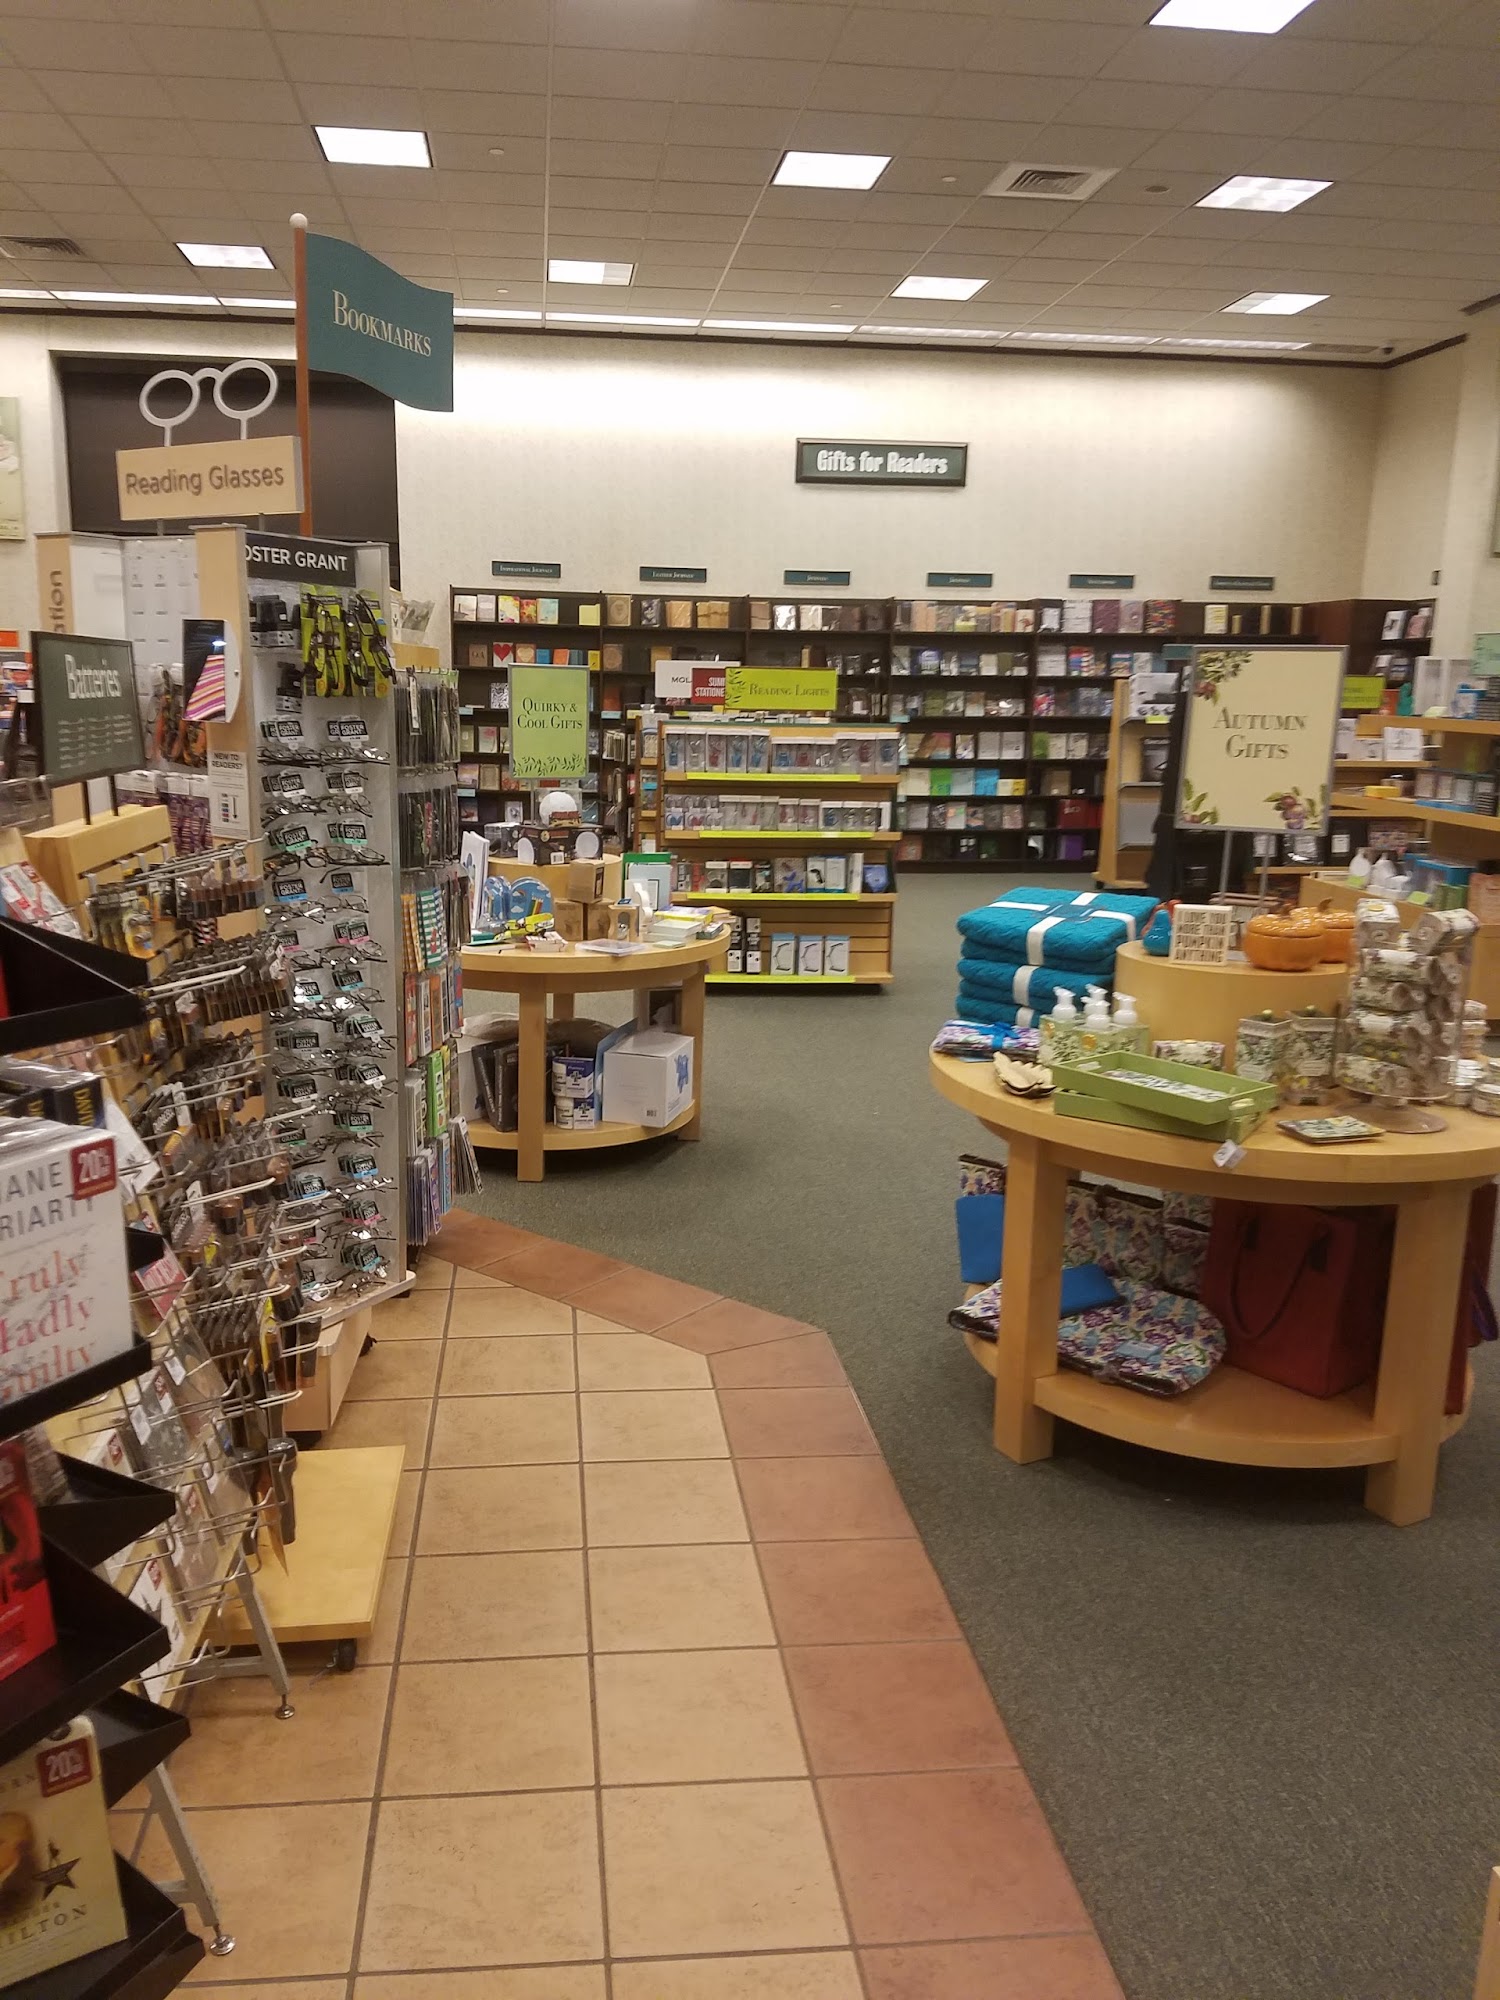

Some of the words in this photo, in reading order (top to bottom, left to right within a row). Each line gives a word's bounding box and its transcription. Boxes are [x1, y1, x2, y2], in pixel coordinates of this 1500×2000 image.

[332, 289, 432, 357] BOOKMARKS
[817, 449, 856, 472] Gifts
[859, 451, 884, 472] for
[886, 451, 948, 474] Readers
[125, 468, 202, 497] Reading
[208, 464, 284, 491] Glasses
[244, 544, 292, 566] OSTER
[294, 551, 348, 571] GRANT
[64, 653, 122, 699] Batteries
[749, 684, 792, 696] READING
[795, 684, 830, 697] LIGHTS
[522, 697, 567, 715] QUIRKY
[569, 703, 578, 713] &
[1210, 706, 1308, 731] AUTUMN
[517, 714, 548, 729] COOL
[550, 715, 583, 729] GIFTS
[213, 752, 228, 760] NEW
[1225, 734, 1290, 759] GIFTS
[0, 1162, 63, 1200] ANE
[0, 1249, 84, 1303] ruly
